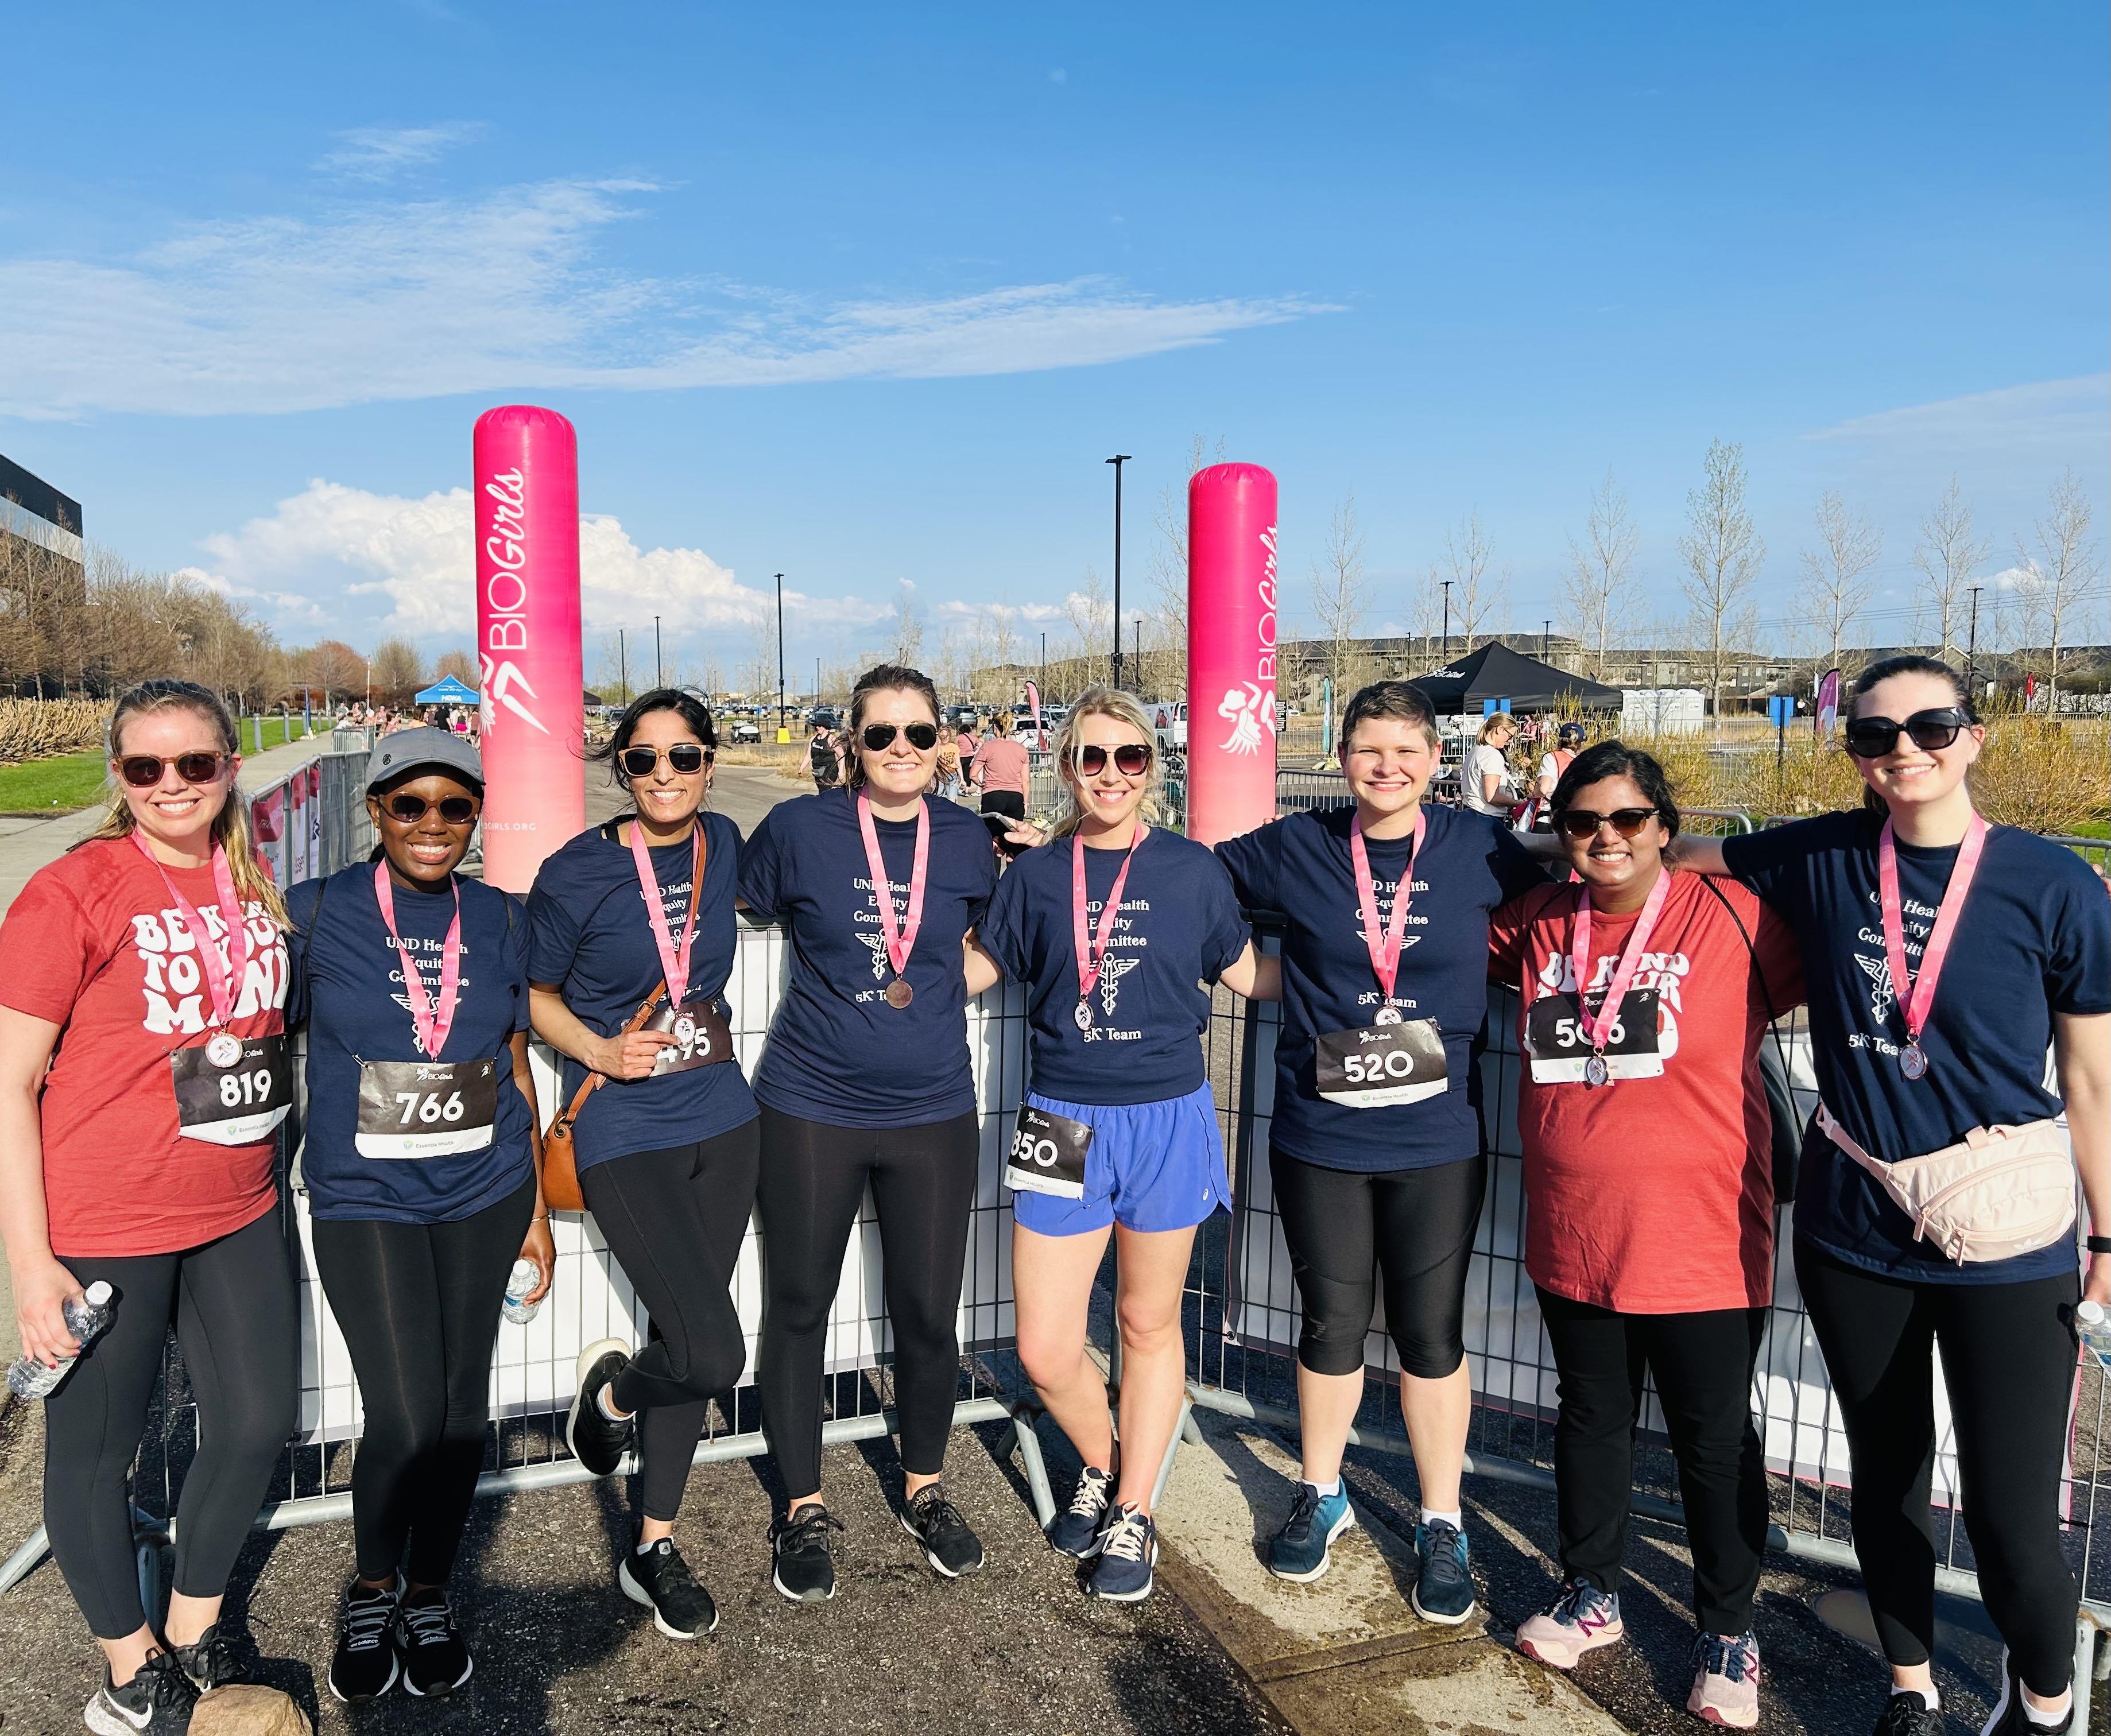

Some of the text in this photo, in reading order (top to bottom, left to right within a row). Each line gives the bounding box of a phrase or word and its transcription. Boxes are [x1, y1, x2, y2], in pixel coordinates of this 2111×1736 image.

[485, 467, 527, 651] BIOGirls
[1386, 880, 1429, 893] Hlth
[662, 898, 687, 912] quity
[867, 895, 908, 911] Eity
[1086, 900, 1150, 912] ND ealth
[1903, 899, 1940, 918] Heal
[1089, 917, 1133, 931] Eity
[423, 939, 468, 954] Heh
[1089, 935, 1147, 948] mittee
[409, 955, 443, 970] quit
[1588, 952, 1690, 987] KND
[138, 948, 200, 994] TO
[142, 946, 289, 1034] MND
[855, 990, 874, 1003] 5K
[1357, 991, 1379, 1005] 5K
[1084, 1027, 1142, 1043] 5K Team
[1848, 1032, 1902, 1056] 5K Tea
[1344, 1050, 1414, 1083] 520
[219, 1069, 272, 1107] 819
[396, 1091, 464, 1124] 766
[1011, 1130, 1058, 1167] 850
[358, 1638, 378, 1646] balance
